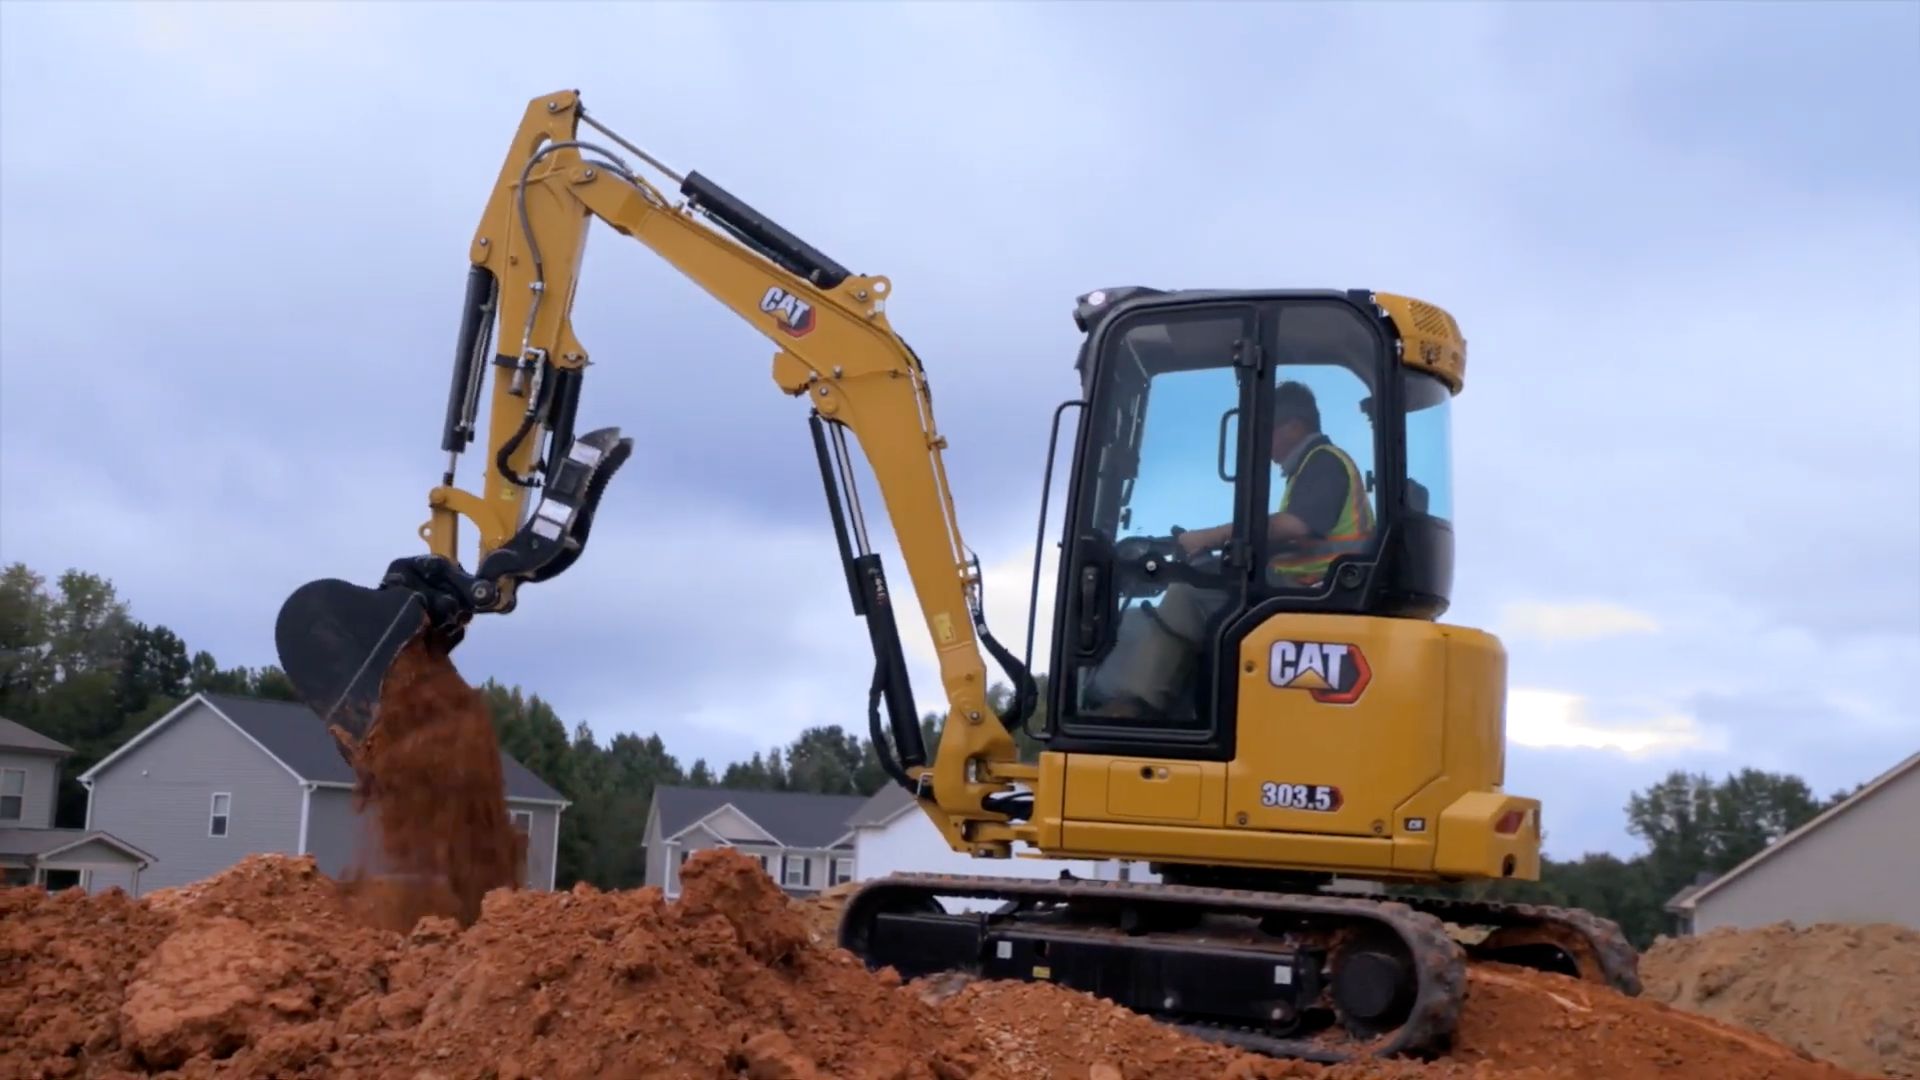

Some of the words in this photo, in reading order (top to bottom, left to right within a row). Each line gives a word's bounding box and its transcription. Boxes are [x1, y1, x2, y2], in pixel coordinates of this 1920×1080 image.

[760, 286, 810, 327] CAT
[1270, 640, 1348, 690] CAT
[1262, 782, 1331, 810] 303.5
